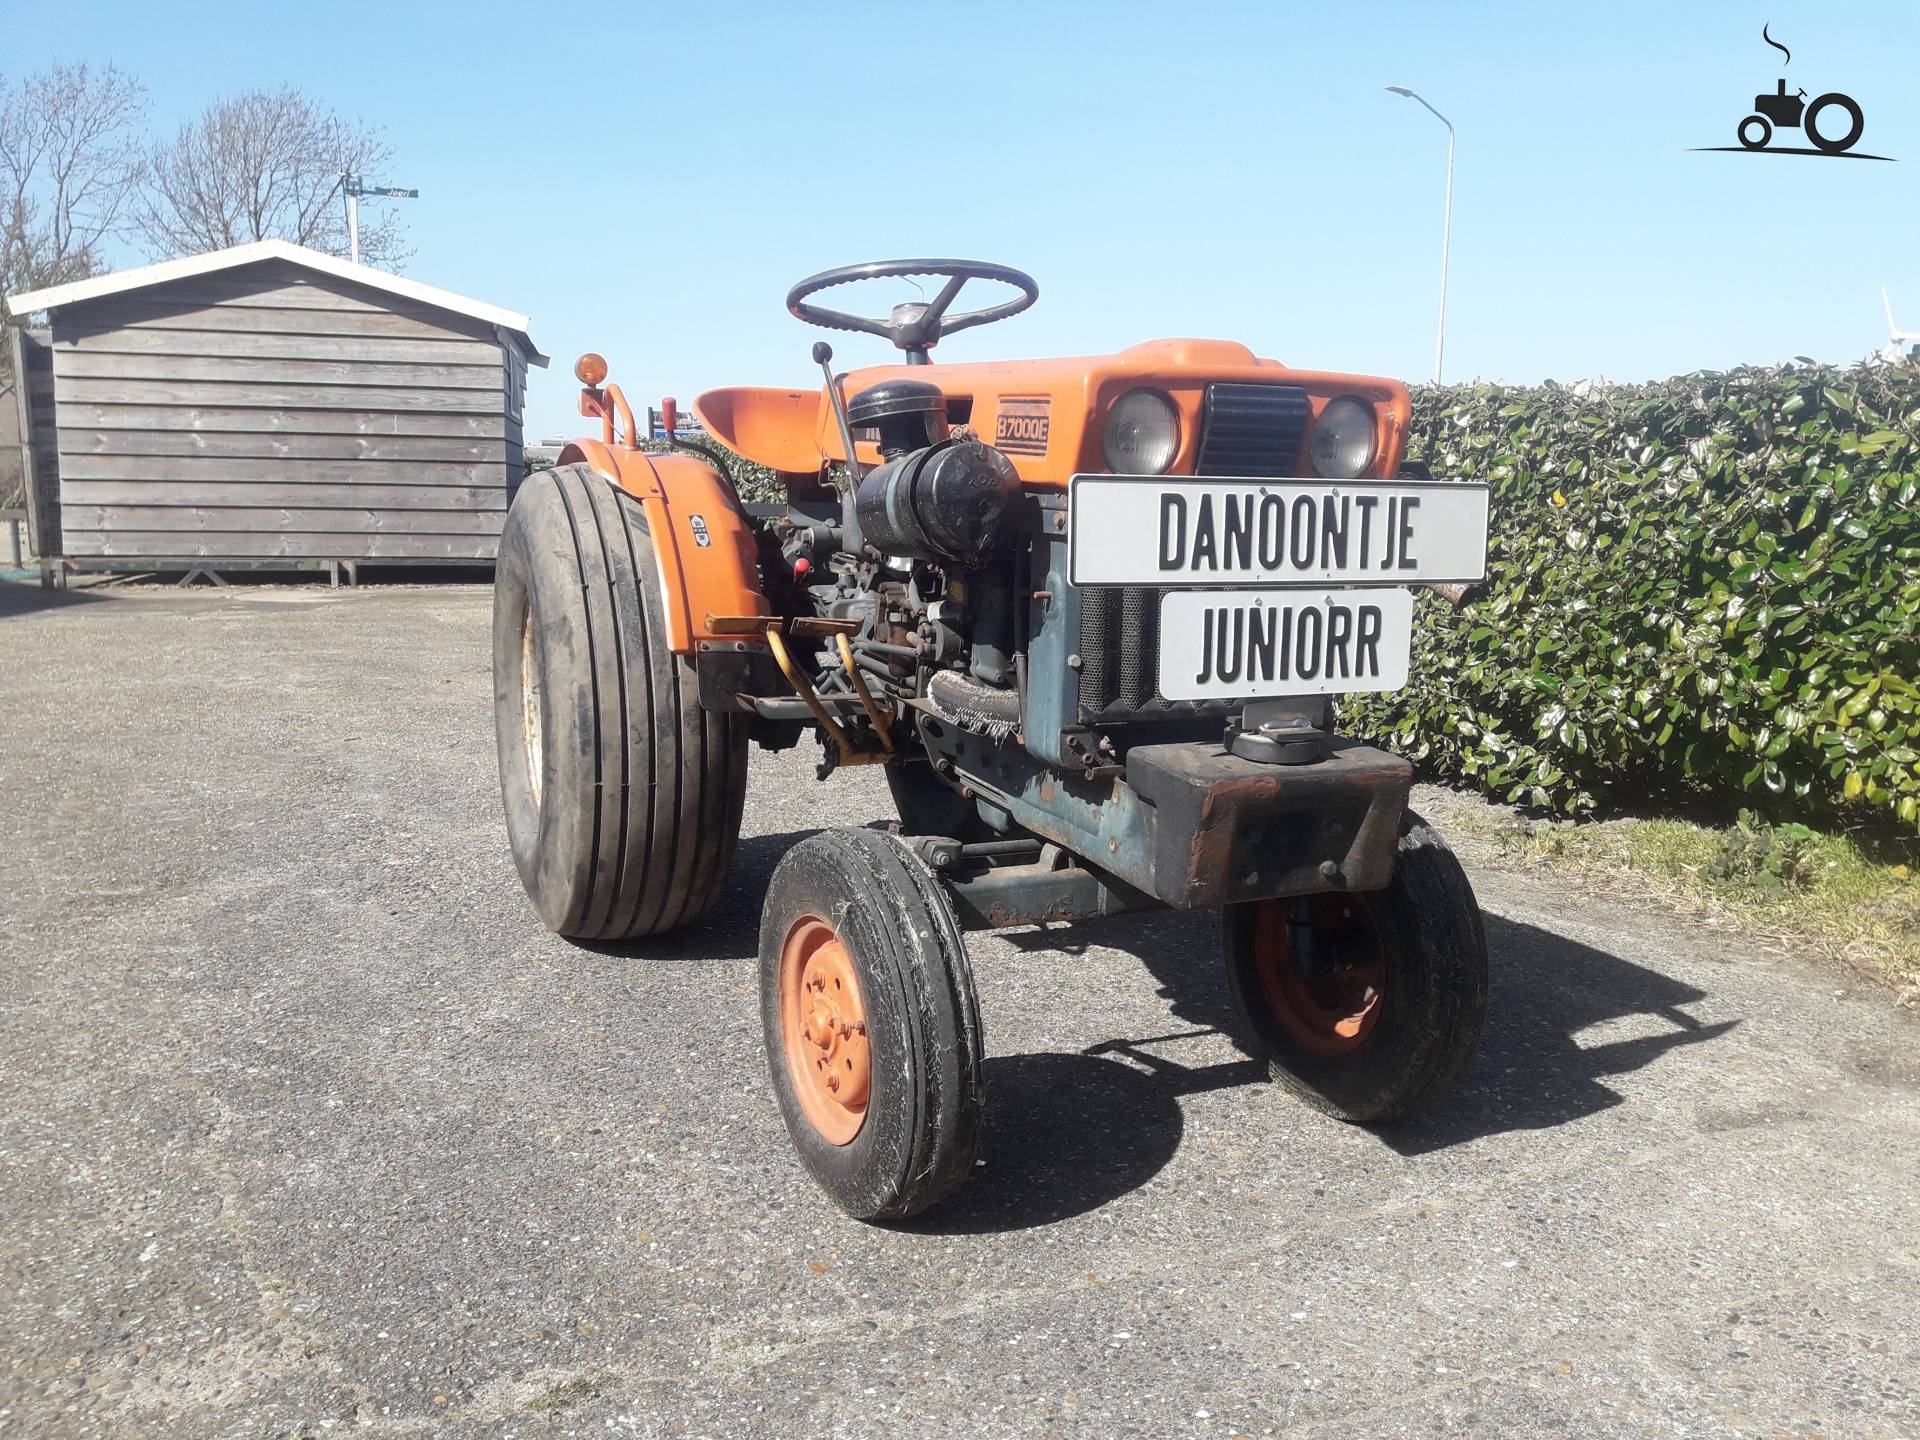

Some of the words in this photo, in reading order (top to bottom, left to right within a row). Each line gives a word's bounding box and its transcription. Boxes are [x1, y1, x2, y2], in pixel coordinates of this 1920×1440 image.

[997, 416, 1048, 440] B7000E
[1158, 493, 1421, 571] DANOONTJE
[1196, 605, 1382, 684] JUNIORR
